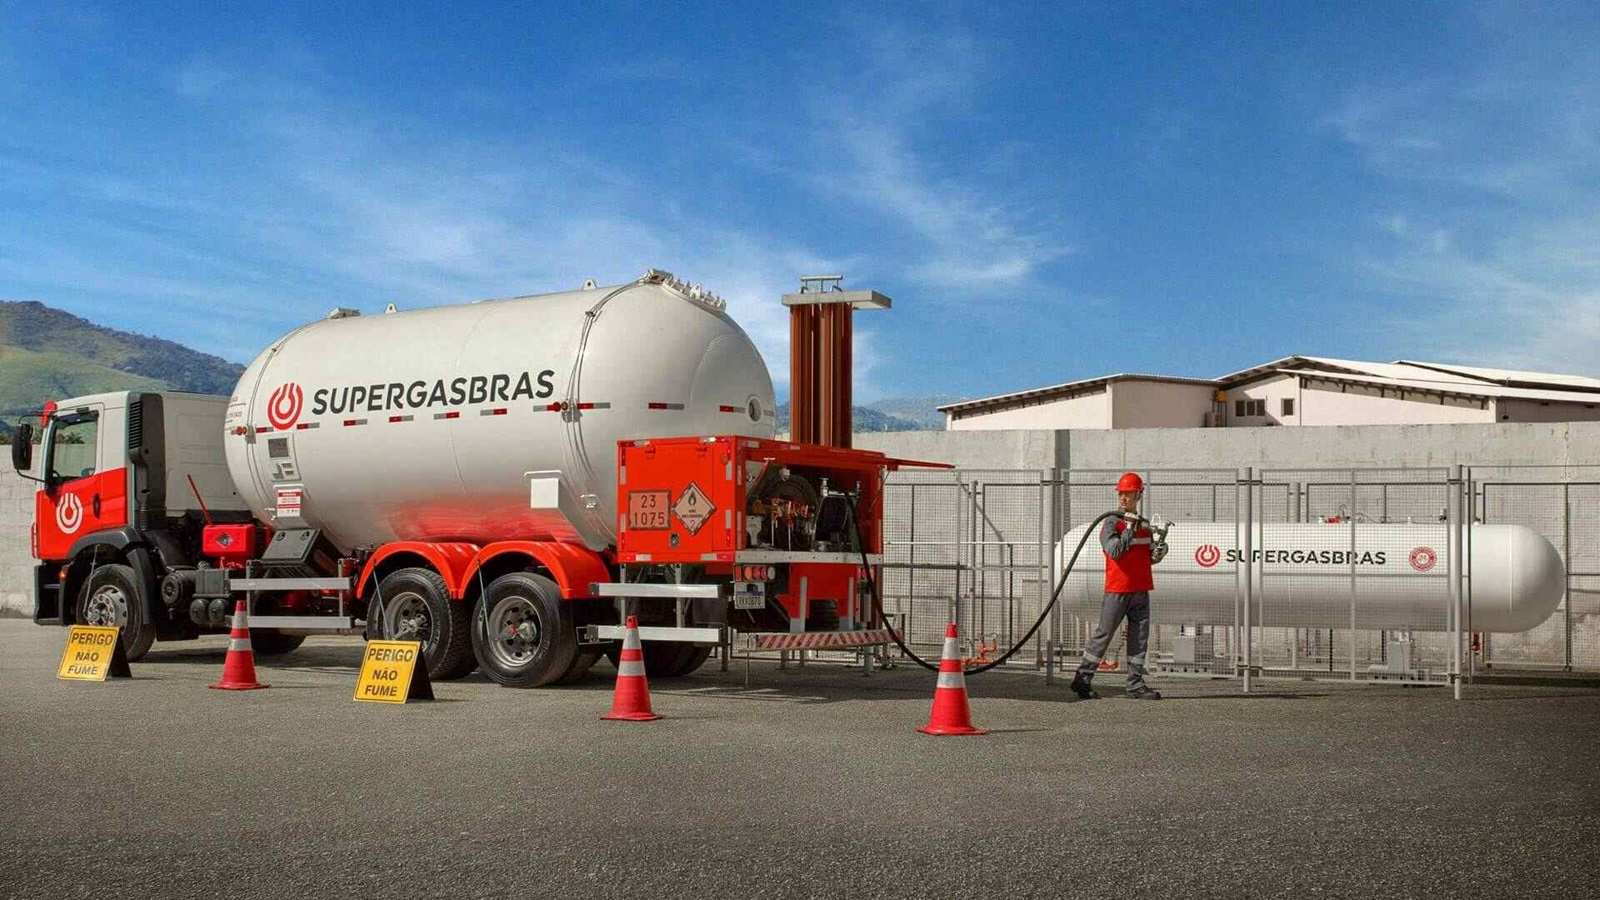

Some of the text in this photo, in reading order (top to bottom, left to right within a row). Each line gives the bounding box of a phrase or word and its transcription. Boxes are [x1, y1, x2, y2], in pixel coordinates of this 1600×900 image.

[311, 369, 556, 416] SUPERGASBRAS
[640, 494, 657, 509] 23
[634, 511, 666, 526] 1075
[71, 632, 114, 646] PERIGO
[75, 649, 100, 662] NÃO
[367, 647, 414, 662] PERIGO
[67, 664, 98, 676] FUME
[372, 667, 399, 681] NÃO
[364, 684, 398, 697] FUME
